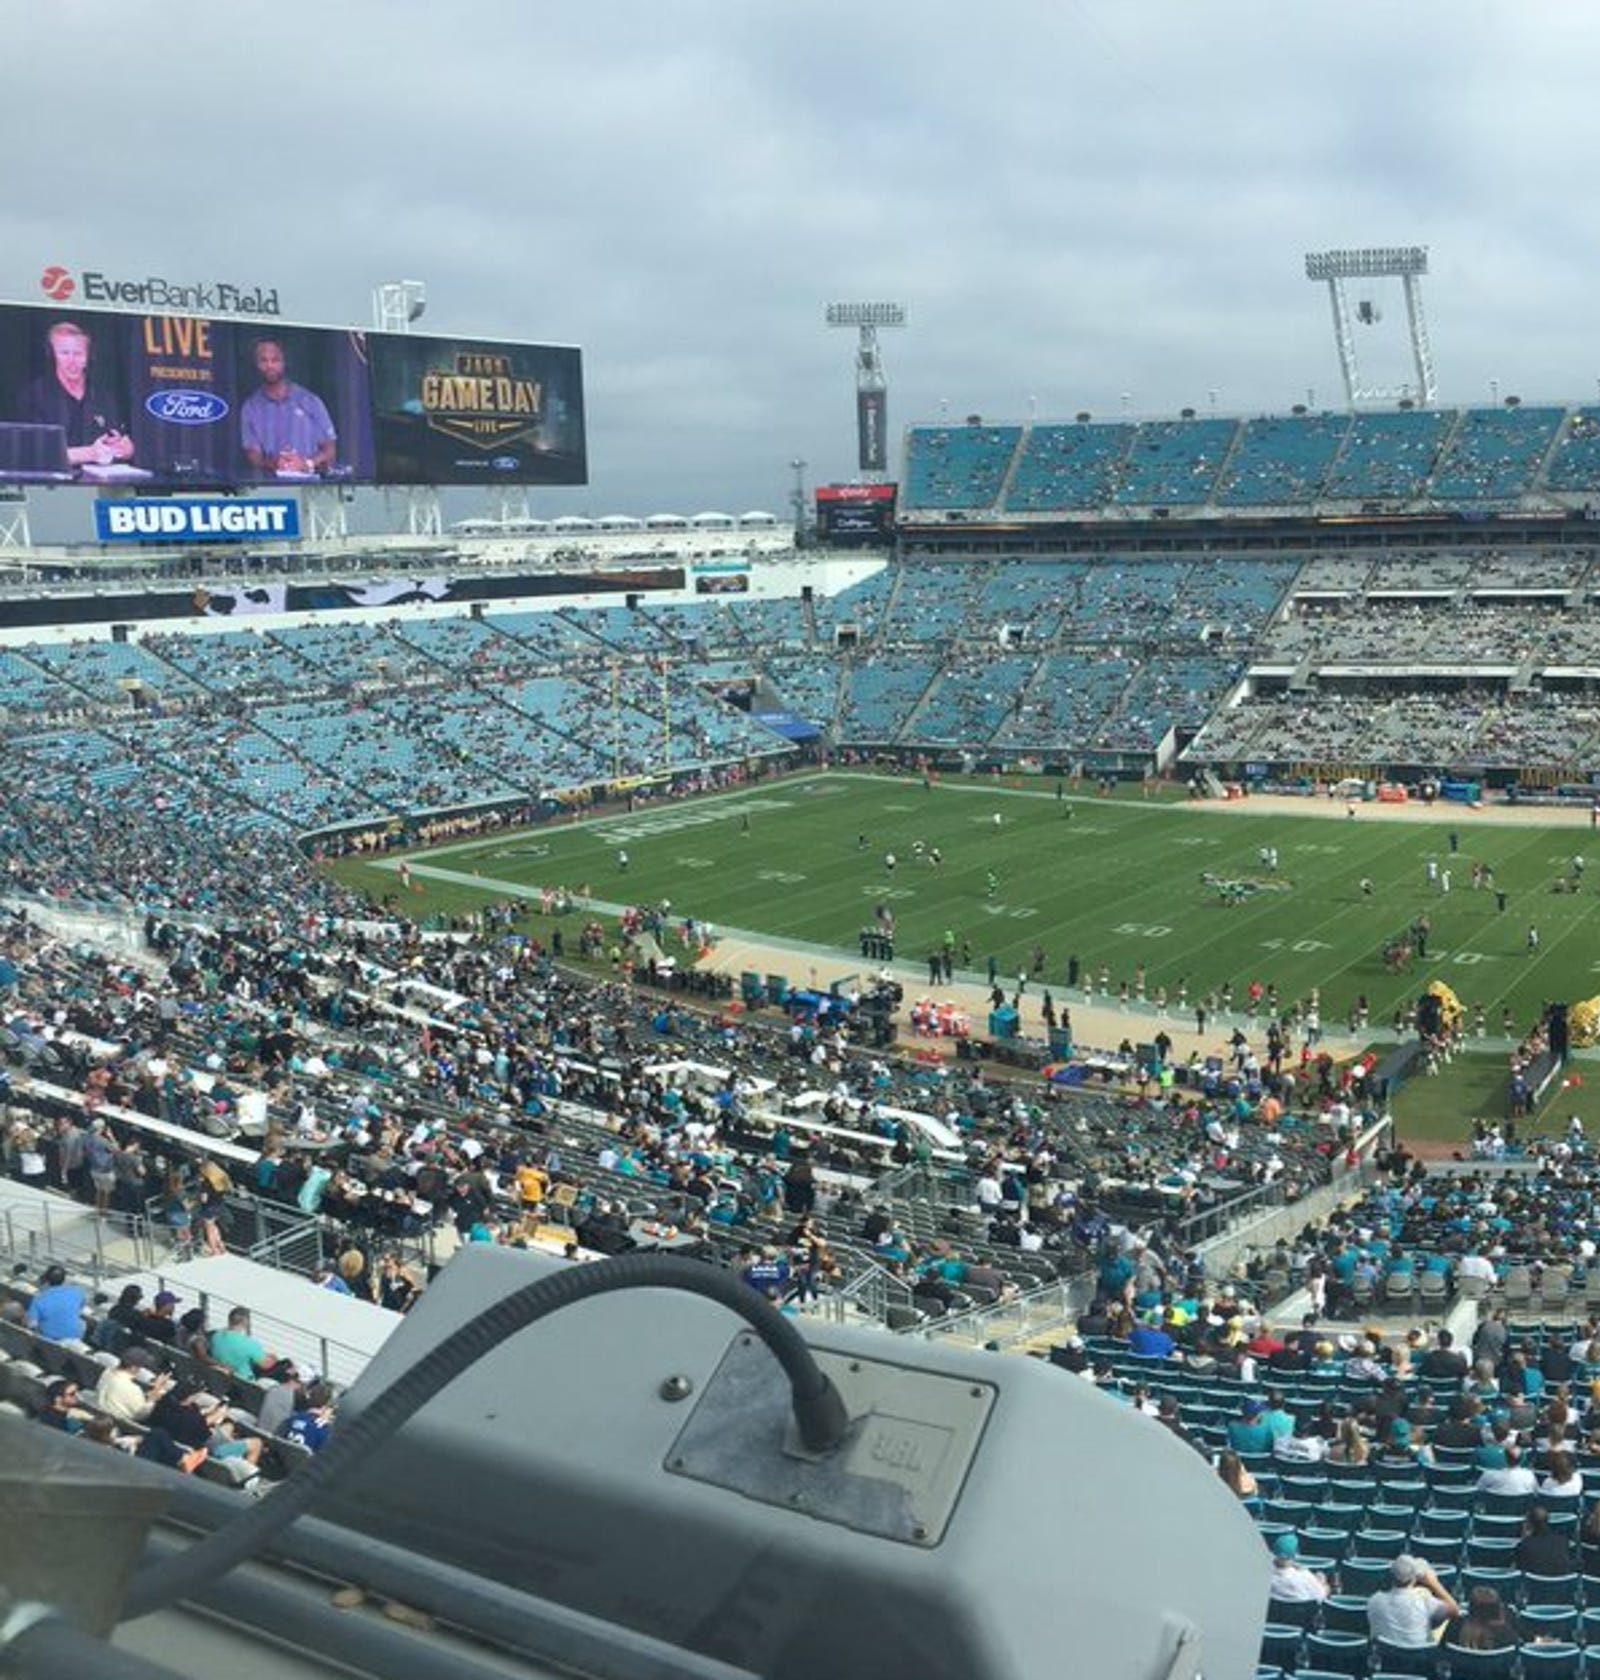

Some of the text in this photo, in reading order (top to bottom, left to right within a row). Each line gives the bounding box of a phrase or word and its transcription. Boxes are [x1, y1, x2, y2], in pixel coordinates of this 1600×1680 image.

[82, 271, 281, 316] EverBank Field
[143, 316, 213, 359] LIVE
[161, 393, 214, 418] Ford
[108, 505, 288, 533] BUD LIGHT
